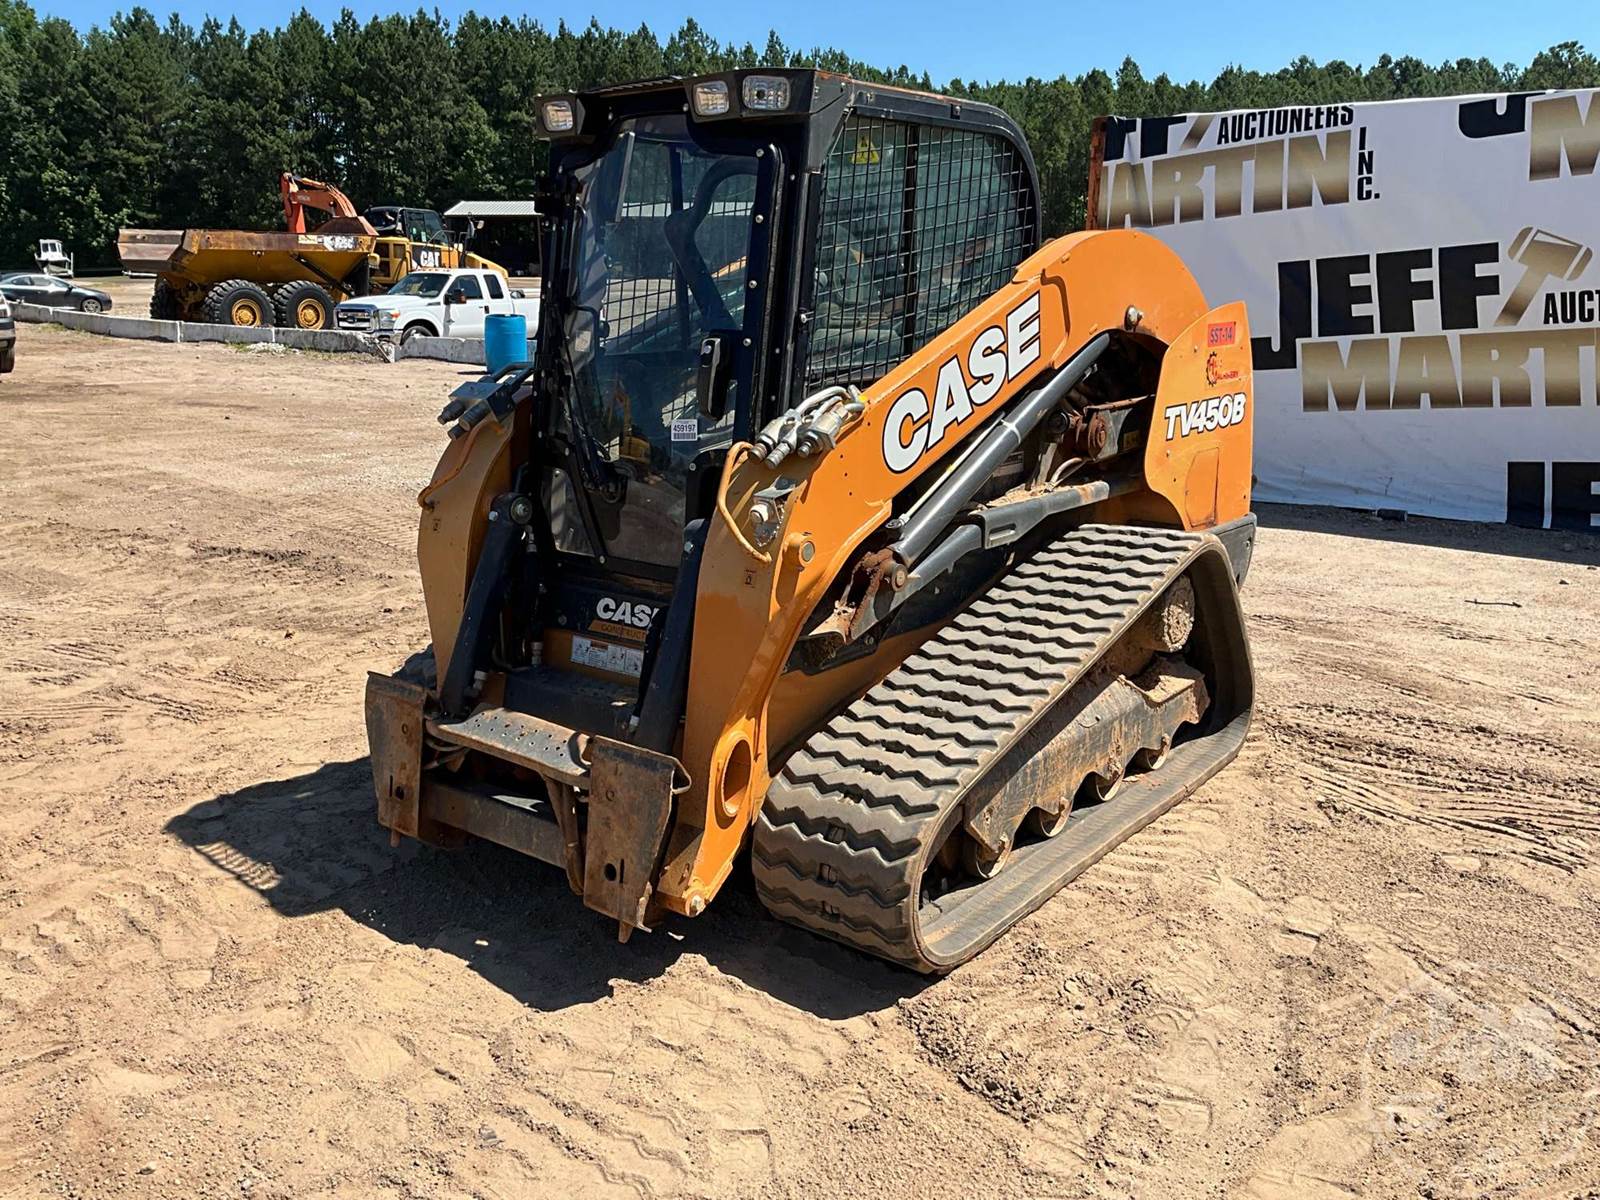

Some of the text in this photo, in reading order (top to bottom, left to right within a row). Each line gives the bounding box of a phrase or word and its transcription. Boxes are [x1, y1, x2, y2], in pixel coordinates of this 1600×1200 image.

[1217, 104, 1354, 145] AUCTIONEERS
[1099, 130, 1351, 230] ARTIN
[1357, 126, 1380, 201] INC.
[420, 250, 441, 267] CAT
[1252, 241, 1500, 371] JEFF
[1543, 289, 1600, 325] AUC
[882, 289, 1041, 474] CASE
[1301, 327, 1600, 412] MART
[673, 424, 696, 433] 459197
[1164, 392, 1247, 441] TV450B
